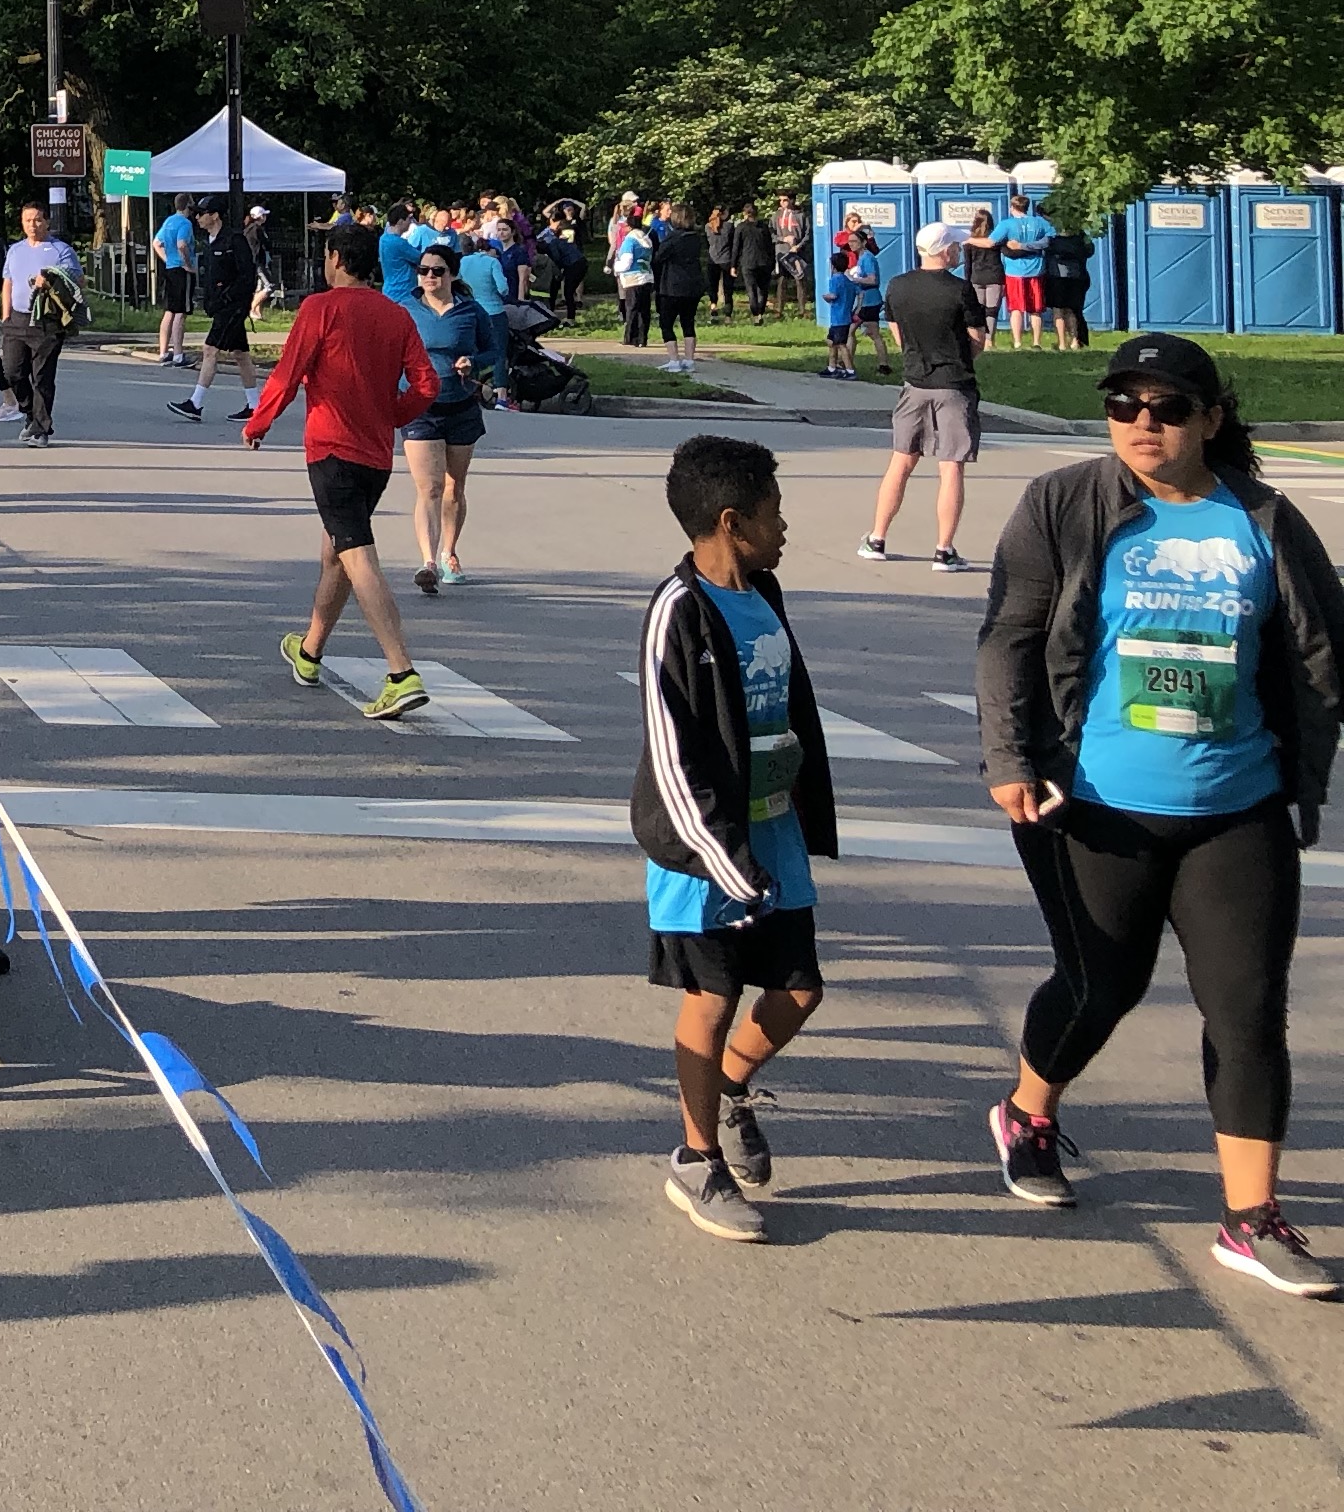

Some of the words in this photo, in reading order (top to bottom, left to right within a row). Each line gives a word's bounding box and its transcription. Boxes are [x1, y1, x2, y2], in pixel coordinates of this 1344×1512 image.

[36, 129, 81, 138] CHICAGO
[36, 139, 80, 148] HISTORY
[37, 148, 81, 157] MUSEUM
[119, 173, 134, 181] Mile
[852, 204, 889, 214] Service
[1158, 205, 1197, 214] Service
[1263, 205, 1304, 215] Service
[1124, 590, 1181, 611] RUN
[1202, 591, 1255, 617] ZOO
[1147, 666, 1208, 696] 2941
